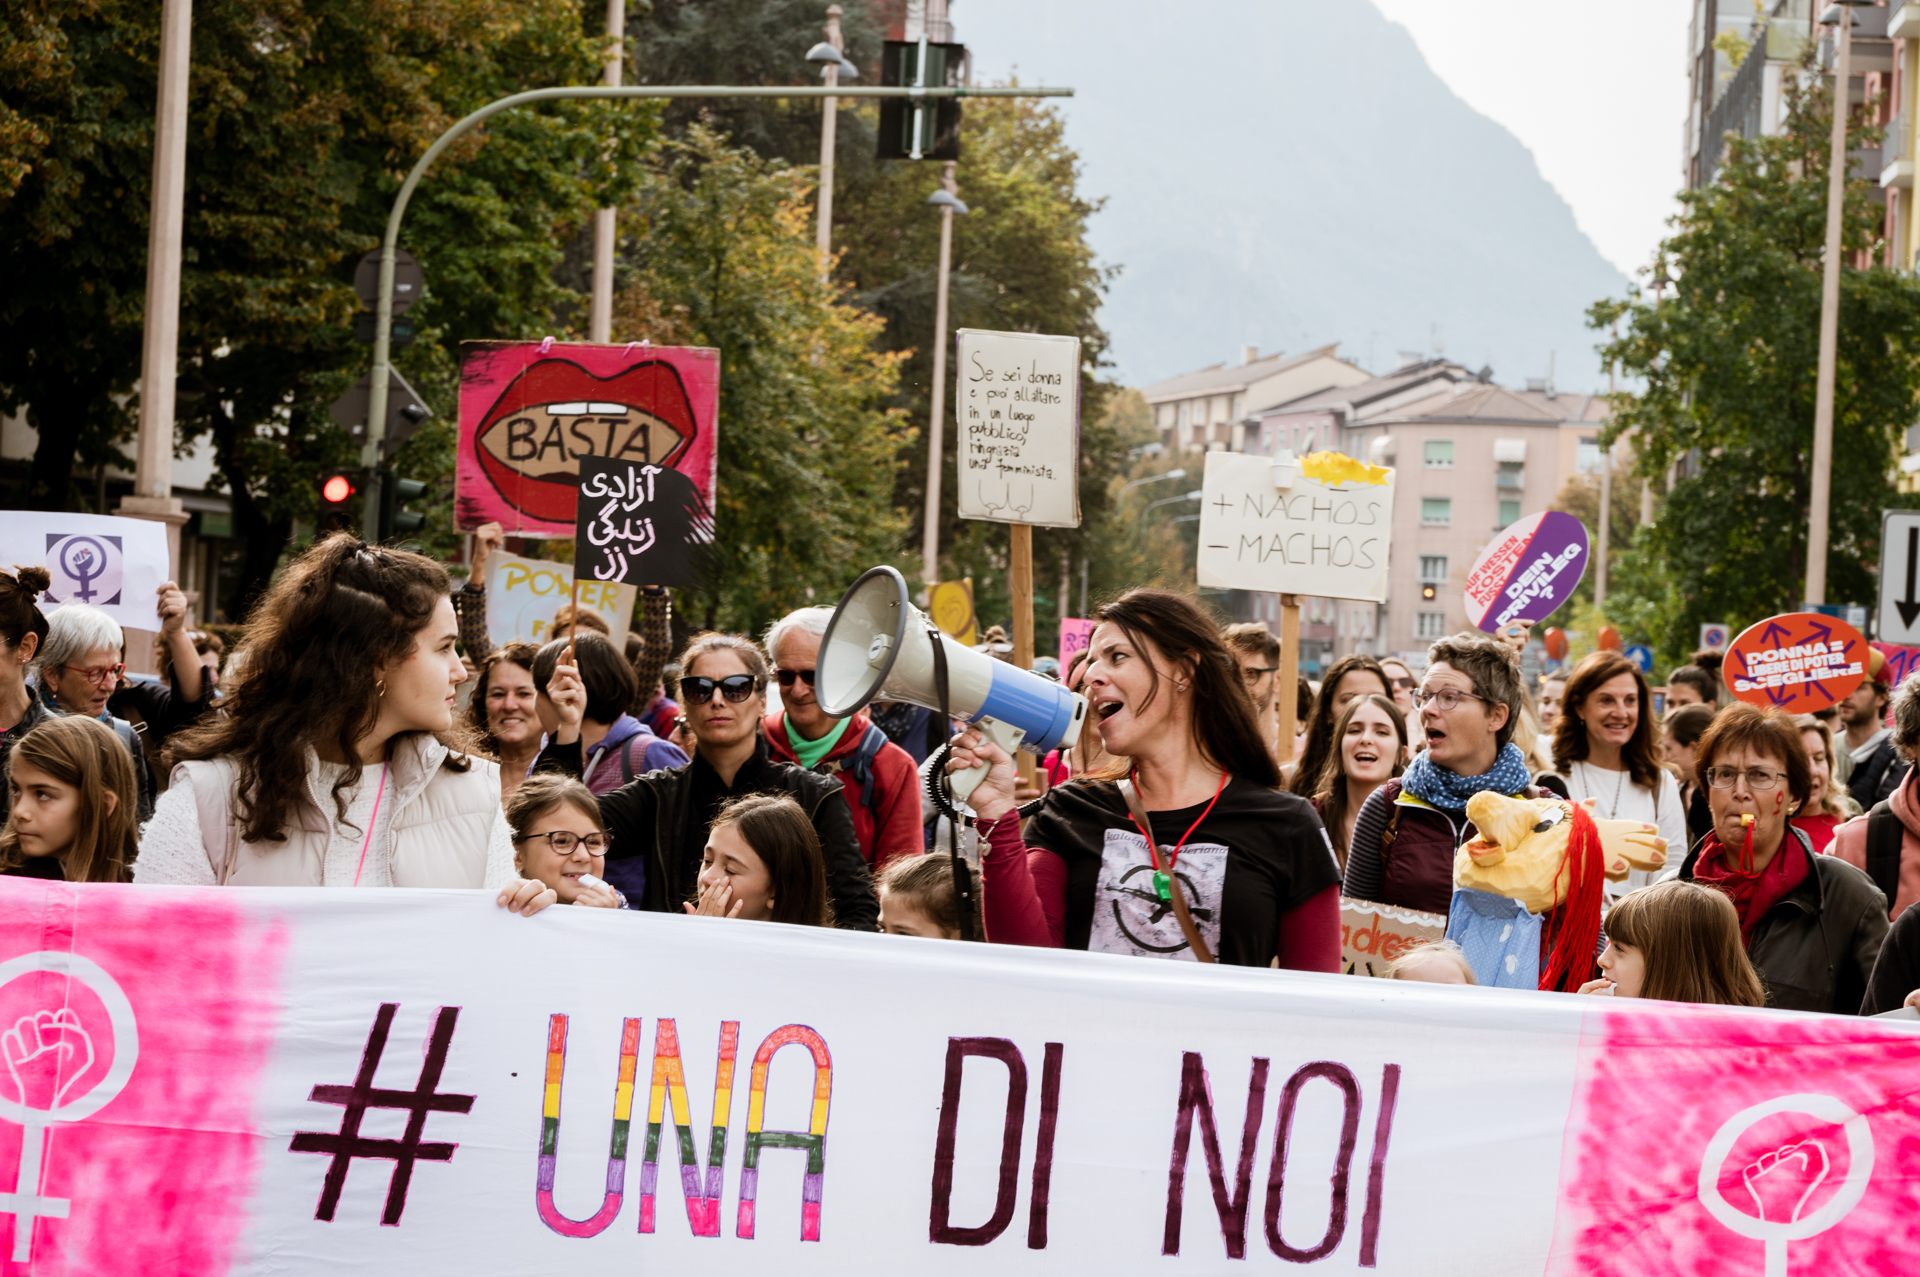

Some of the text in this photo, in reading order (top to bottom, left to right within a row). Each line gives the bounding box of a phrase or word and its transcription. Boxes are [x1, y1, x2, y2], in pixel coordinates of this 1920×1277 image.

[969, 350, 1062, 385] Se sei donna
[969, 386, 1061, 405] e puoi allattare
[969, 403, 1035, 434] in un luogo
[507, 417, 650, 463] BASTA
[969, 438, 1020, 463] ringrazia
[968, 458, 987, 470] una
[1242, 493, 1381, 525] NACHOS
[1237, 532, 1378, 570] MACHOS
[1479, 535, 1519, 574] WESSEN
[500, 562, 621, 613] POWER
[1495, 543, 1583, 627] PRIVILEG
[1505, 551, 1554, 600] DEIN
[1539, 585, 1554, 600] ?
[1745, 642, 1829, 665] DONNA
[1747, 652, 1846, 678] LIBERE DI POTER
[1733, 661, 1864, 692] SCEGLIERE
[288, 1002, 1402, 1269] # UNA DI NOI
